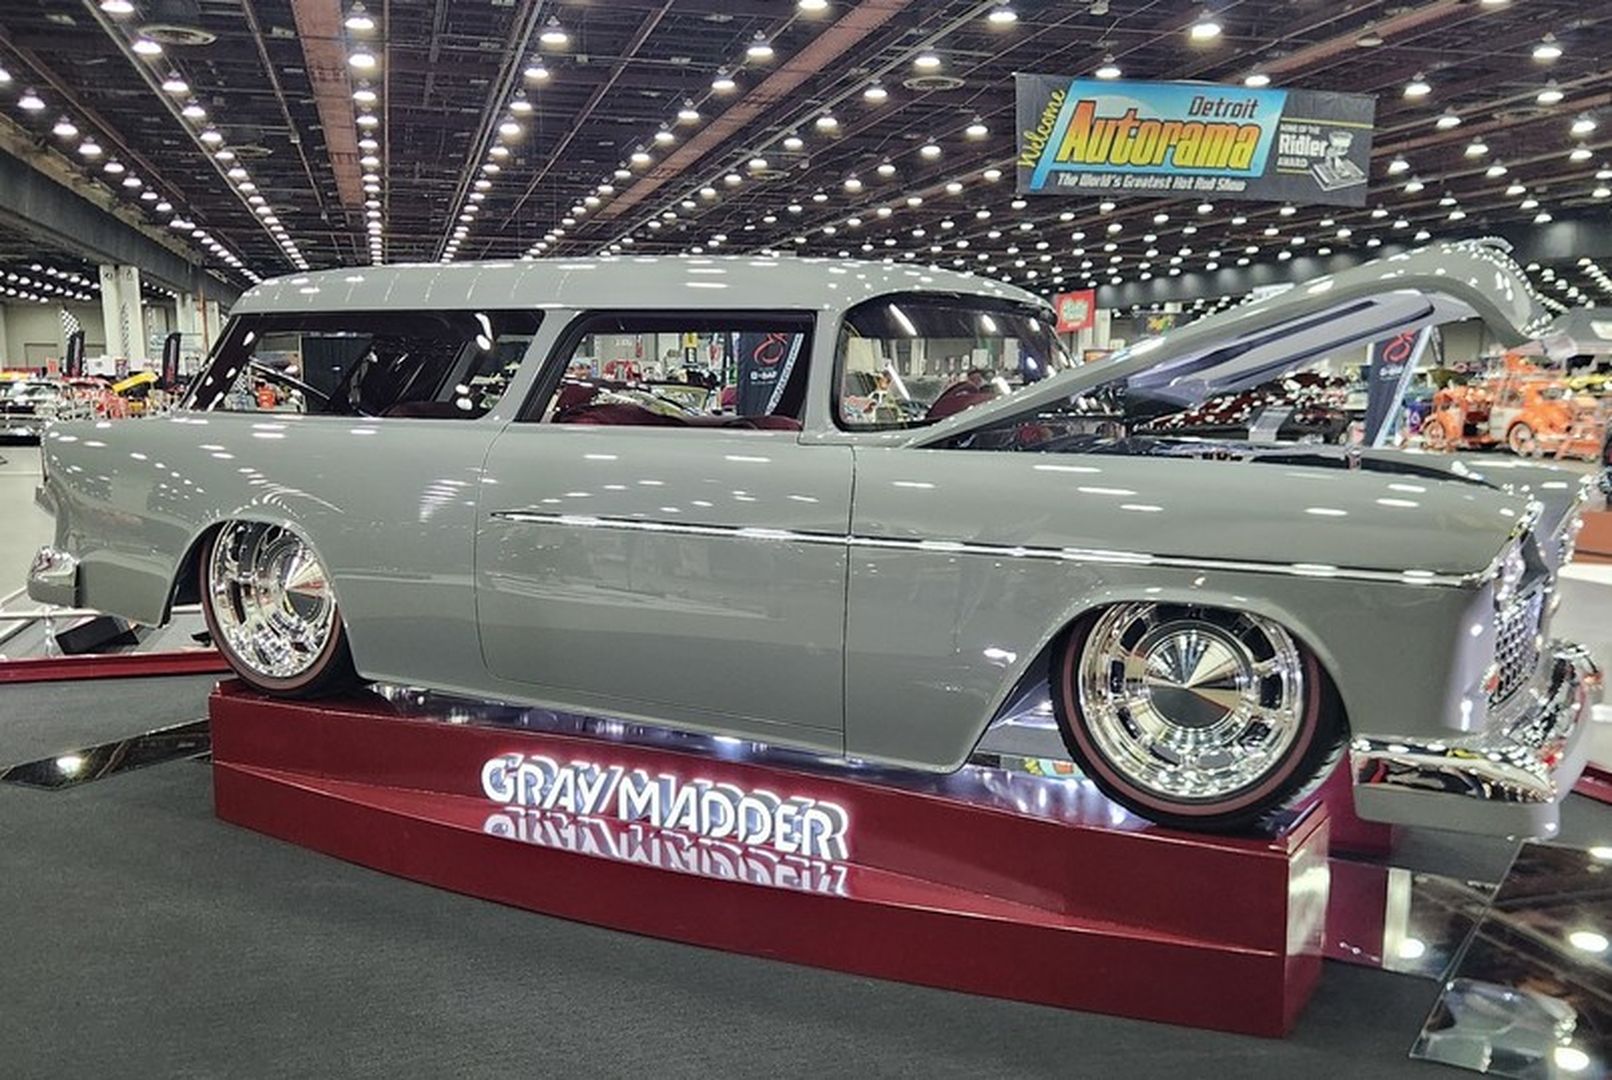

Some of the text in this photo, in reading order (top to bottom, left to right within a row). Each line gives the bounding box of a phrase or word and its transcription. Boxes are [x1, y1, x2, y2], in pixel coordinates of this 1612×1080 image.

[1188, 95, 1259, 119] Detroit
[1016, 89, 1066, 167] Welcome
[1055, 99, 1263, 170] Autorama
[1279, 133, 1329, 157] Ridler
[1057, 173, 1247, 191] The World's Greatest Hot Rod Show
